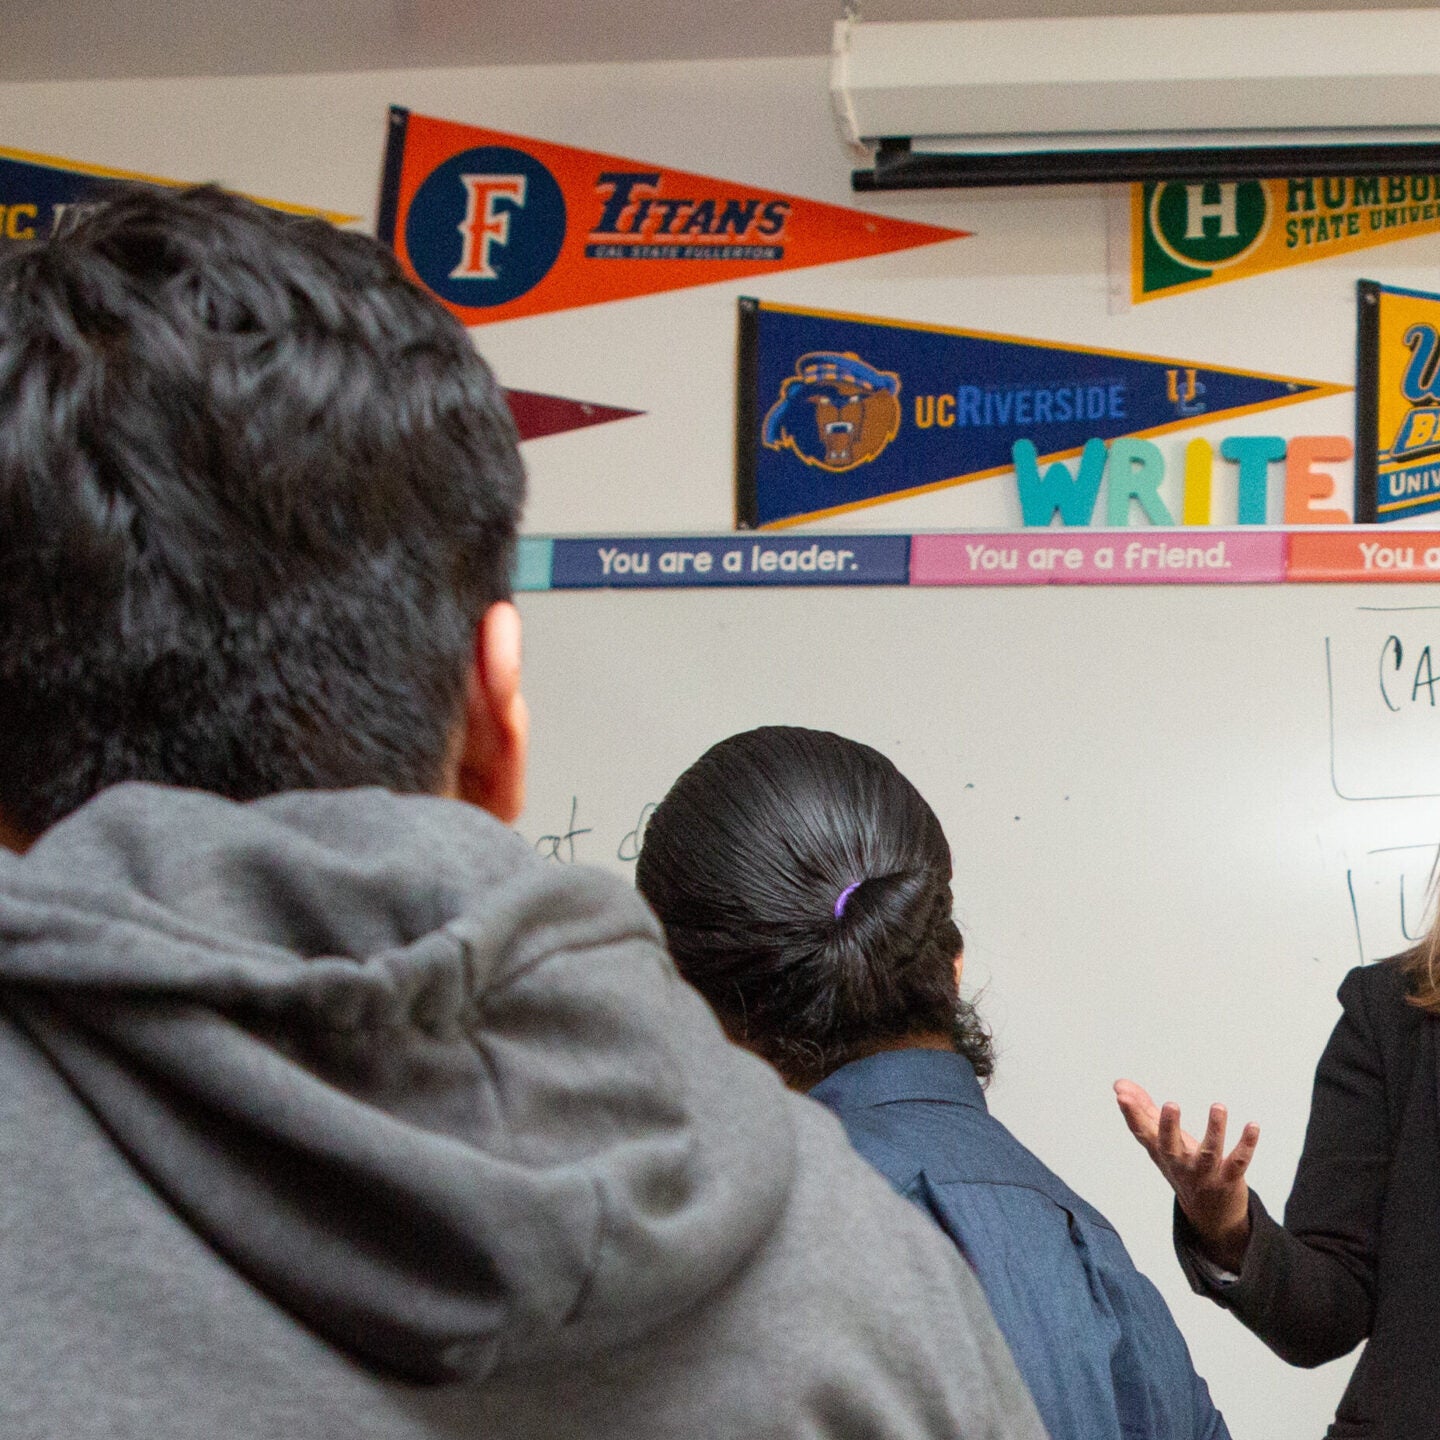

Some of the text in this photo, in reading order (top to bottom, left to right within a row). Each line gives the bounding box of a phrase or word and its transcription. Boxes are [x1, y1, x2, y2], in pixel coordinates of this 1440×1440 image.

[447, 171, 528, 280] F
[1183, 184, 1239, 239] H
[1285, 212, 1361, 249] STATE
[1012, 435, 1354, 527] WRITE
[598, 544, 858, 575] You are a leader.
[965, 540, 1232, 571] You are a friend.
[1358, 541, 1414, 570] You
